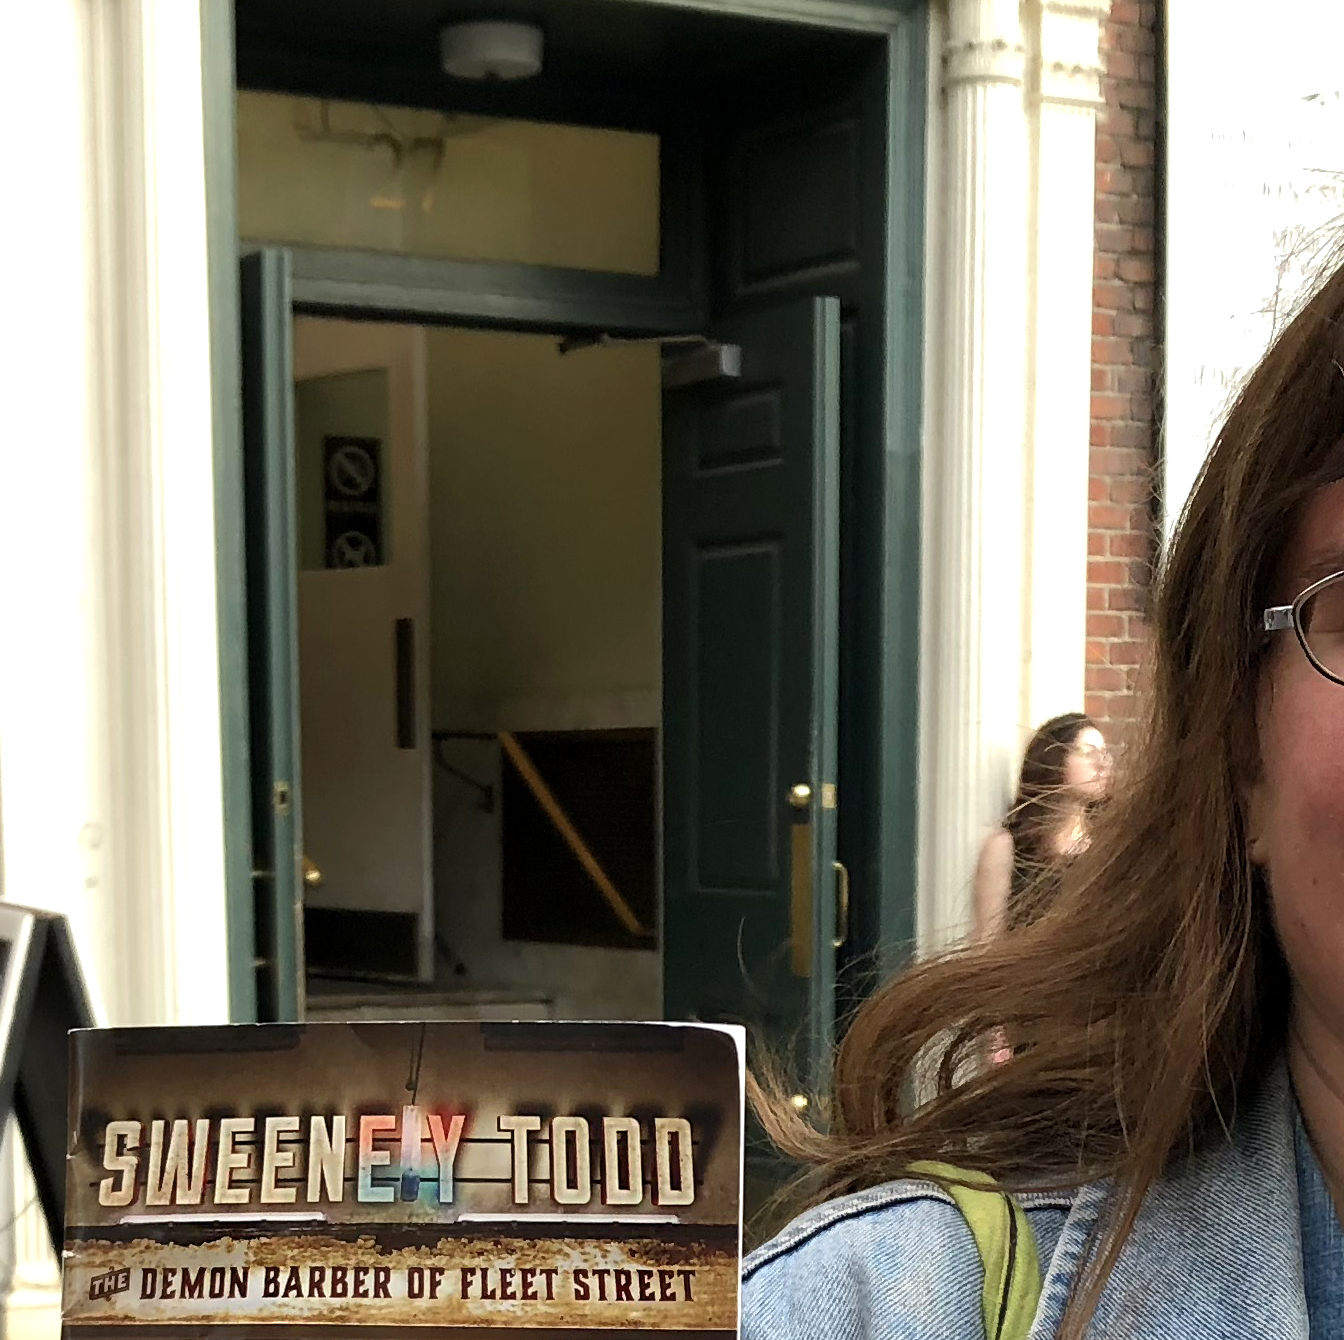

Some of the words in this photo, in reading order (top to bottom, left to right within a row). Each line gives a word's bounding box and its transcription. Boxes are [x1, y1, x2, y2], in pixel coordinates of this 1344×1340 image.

[97, 1113, 467, 1208] SWEENEY
[496, 1113, 697, 1207] TODD
[89, 1268, 130, 1299] THE
[139, 1266, 251, 1300] DEMON
[262, 1265, 394, 1300] BARBER
[407, 1266, 446, 1300] OF
[459, 1266, 559, 1301] FLEET
[572, 1267, 697, 1302] STREET
